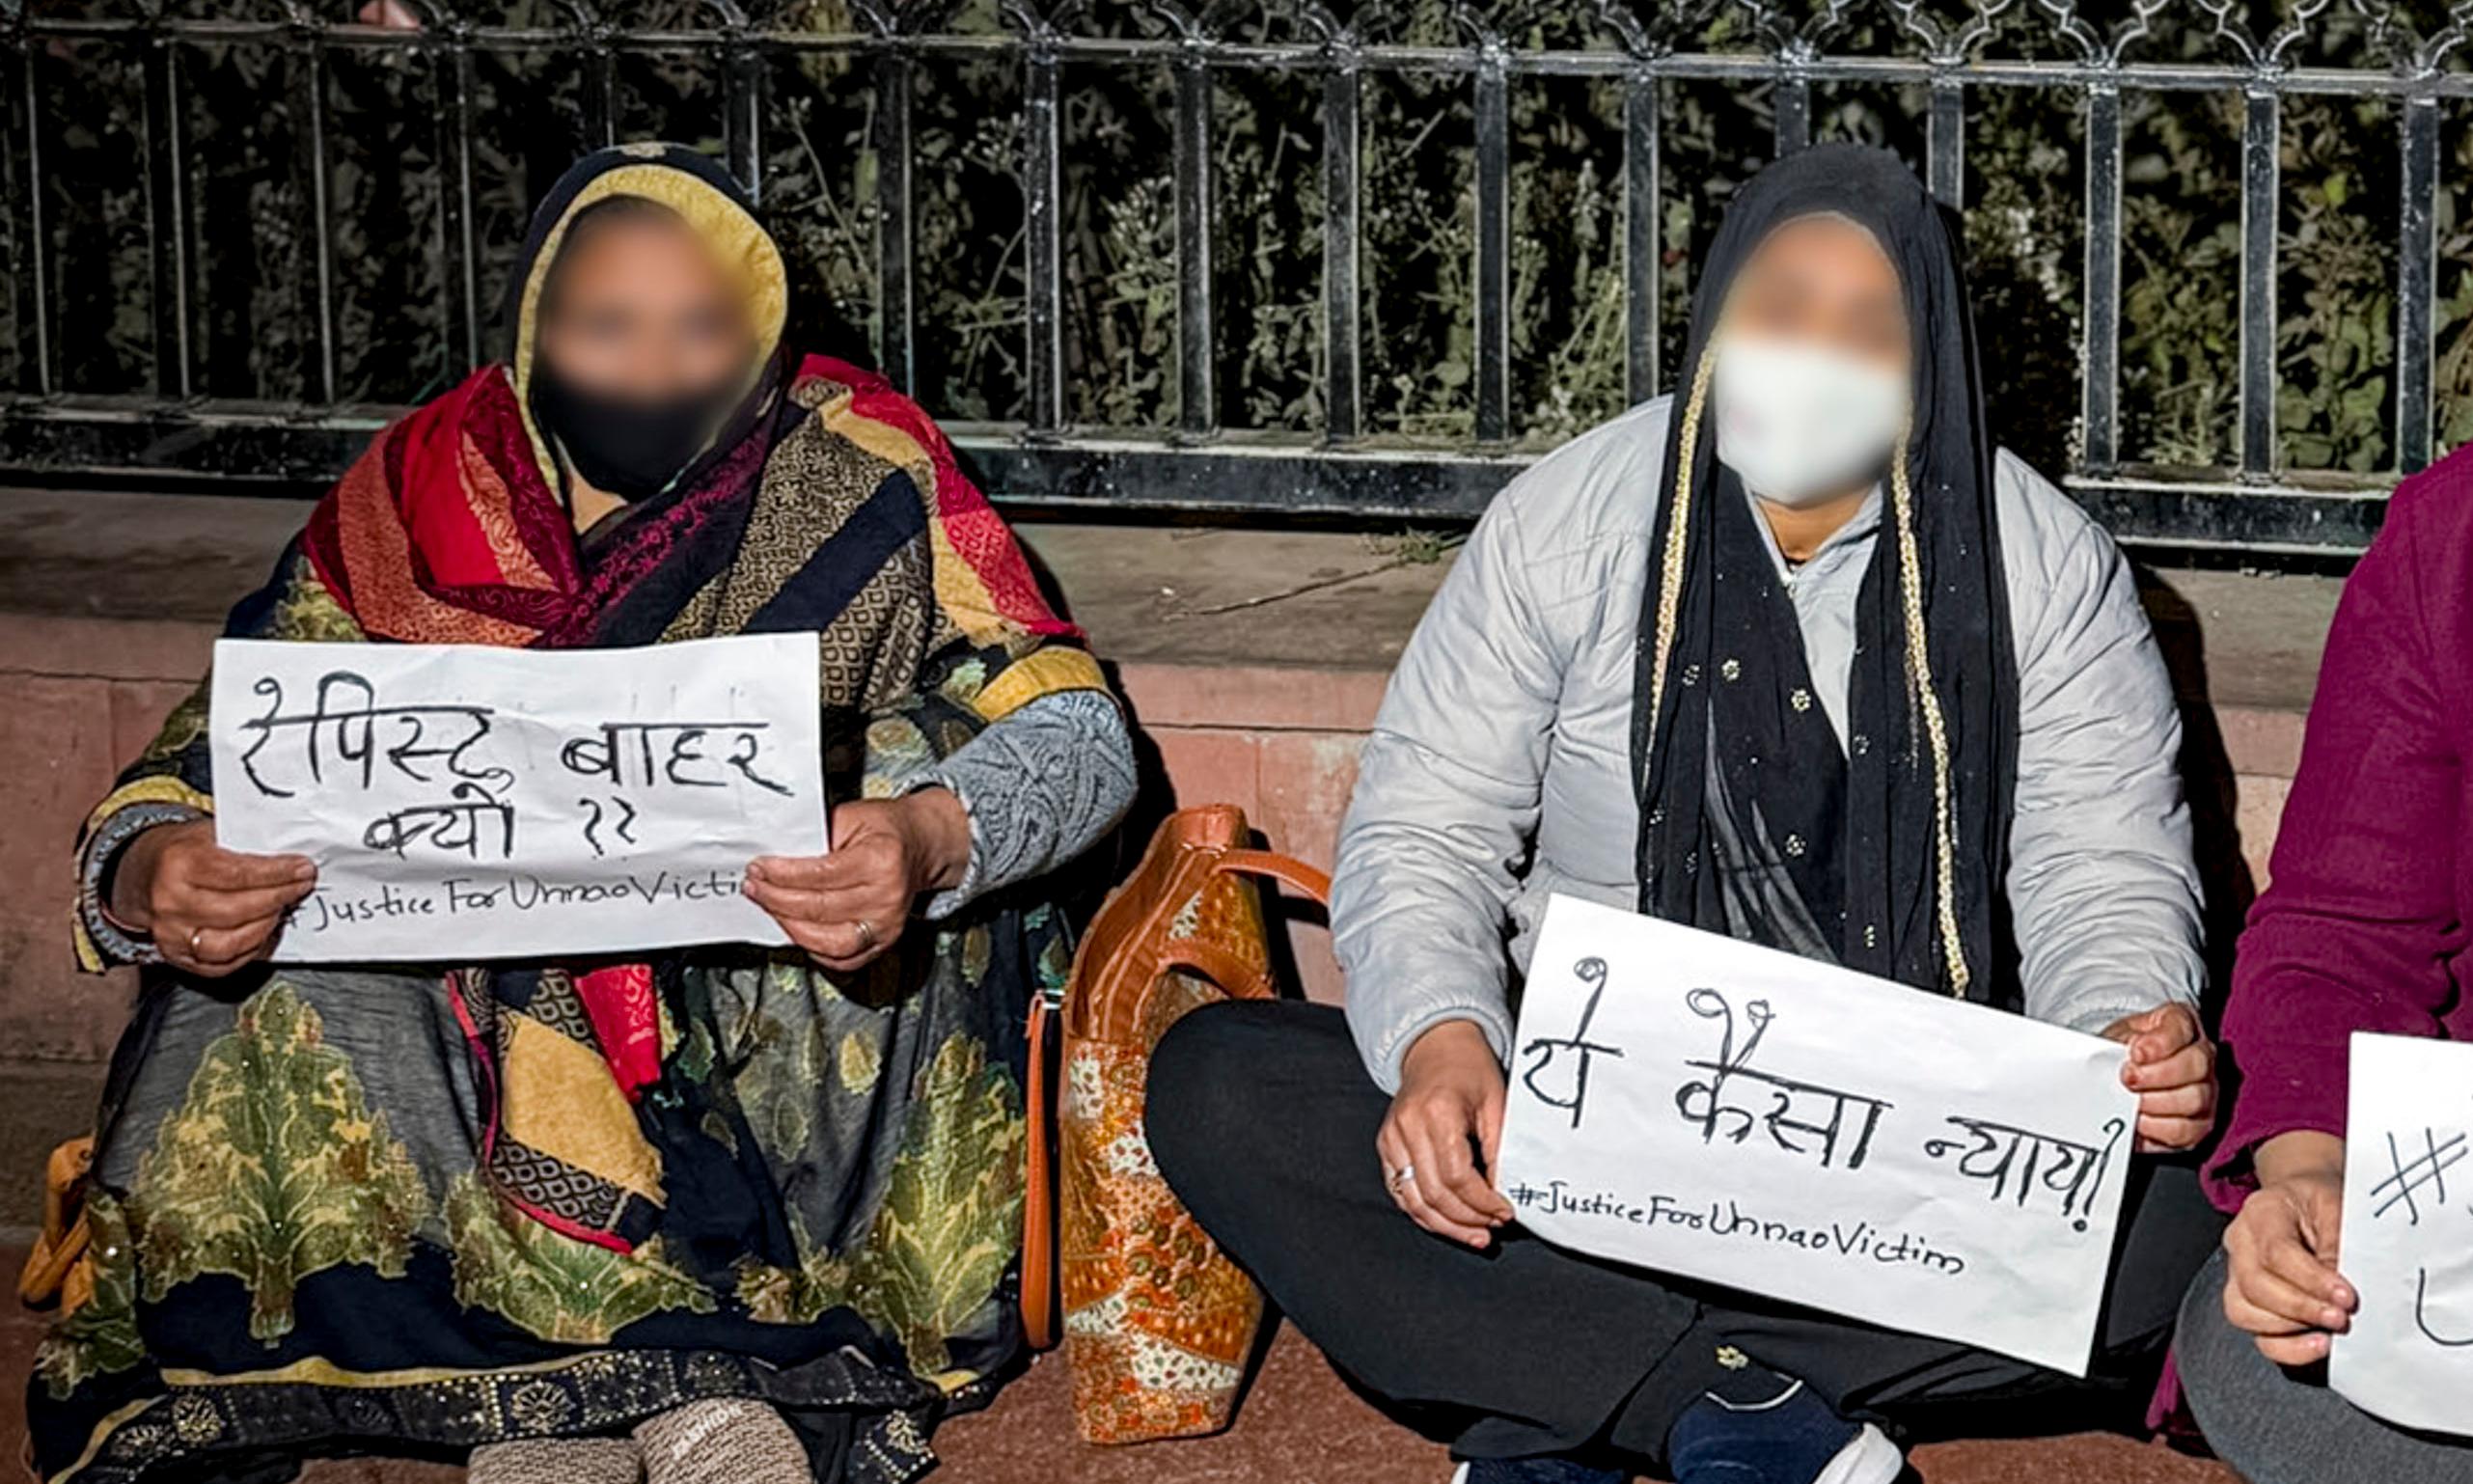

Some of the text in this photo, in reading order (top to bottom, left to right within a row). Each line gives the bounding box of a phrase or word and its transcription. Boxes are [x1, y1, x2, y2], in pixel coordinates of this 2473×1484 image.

[561, 721, 794, 797] बाहर
[1523, 956, 1624, 1128] ये
[1675, 987, 1894, 1170] कैसा
